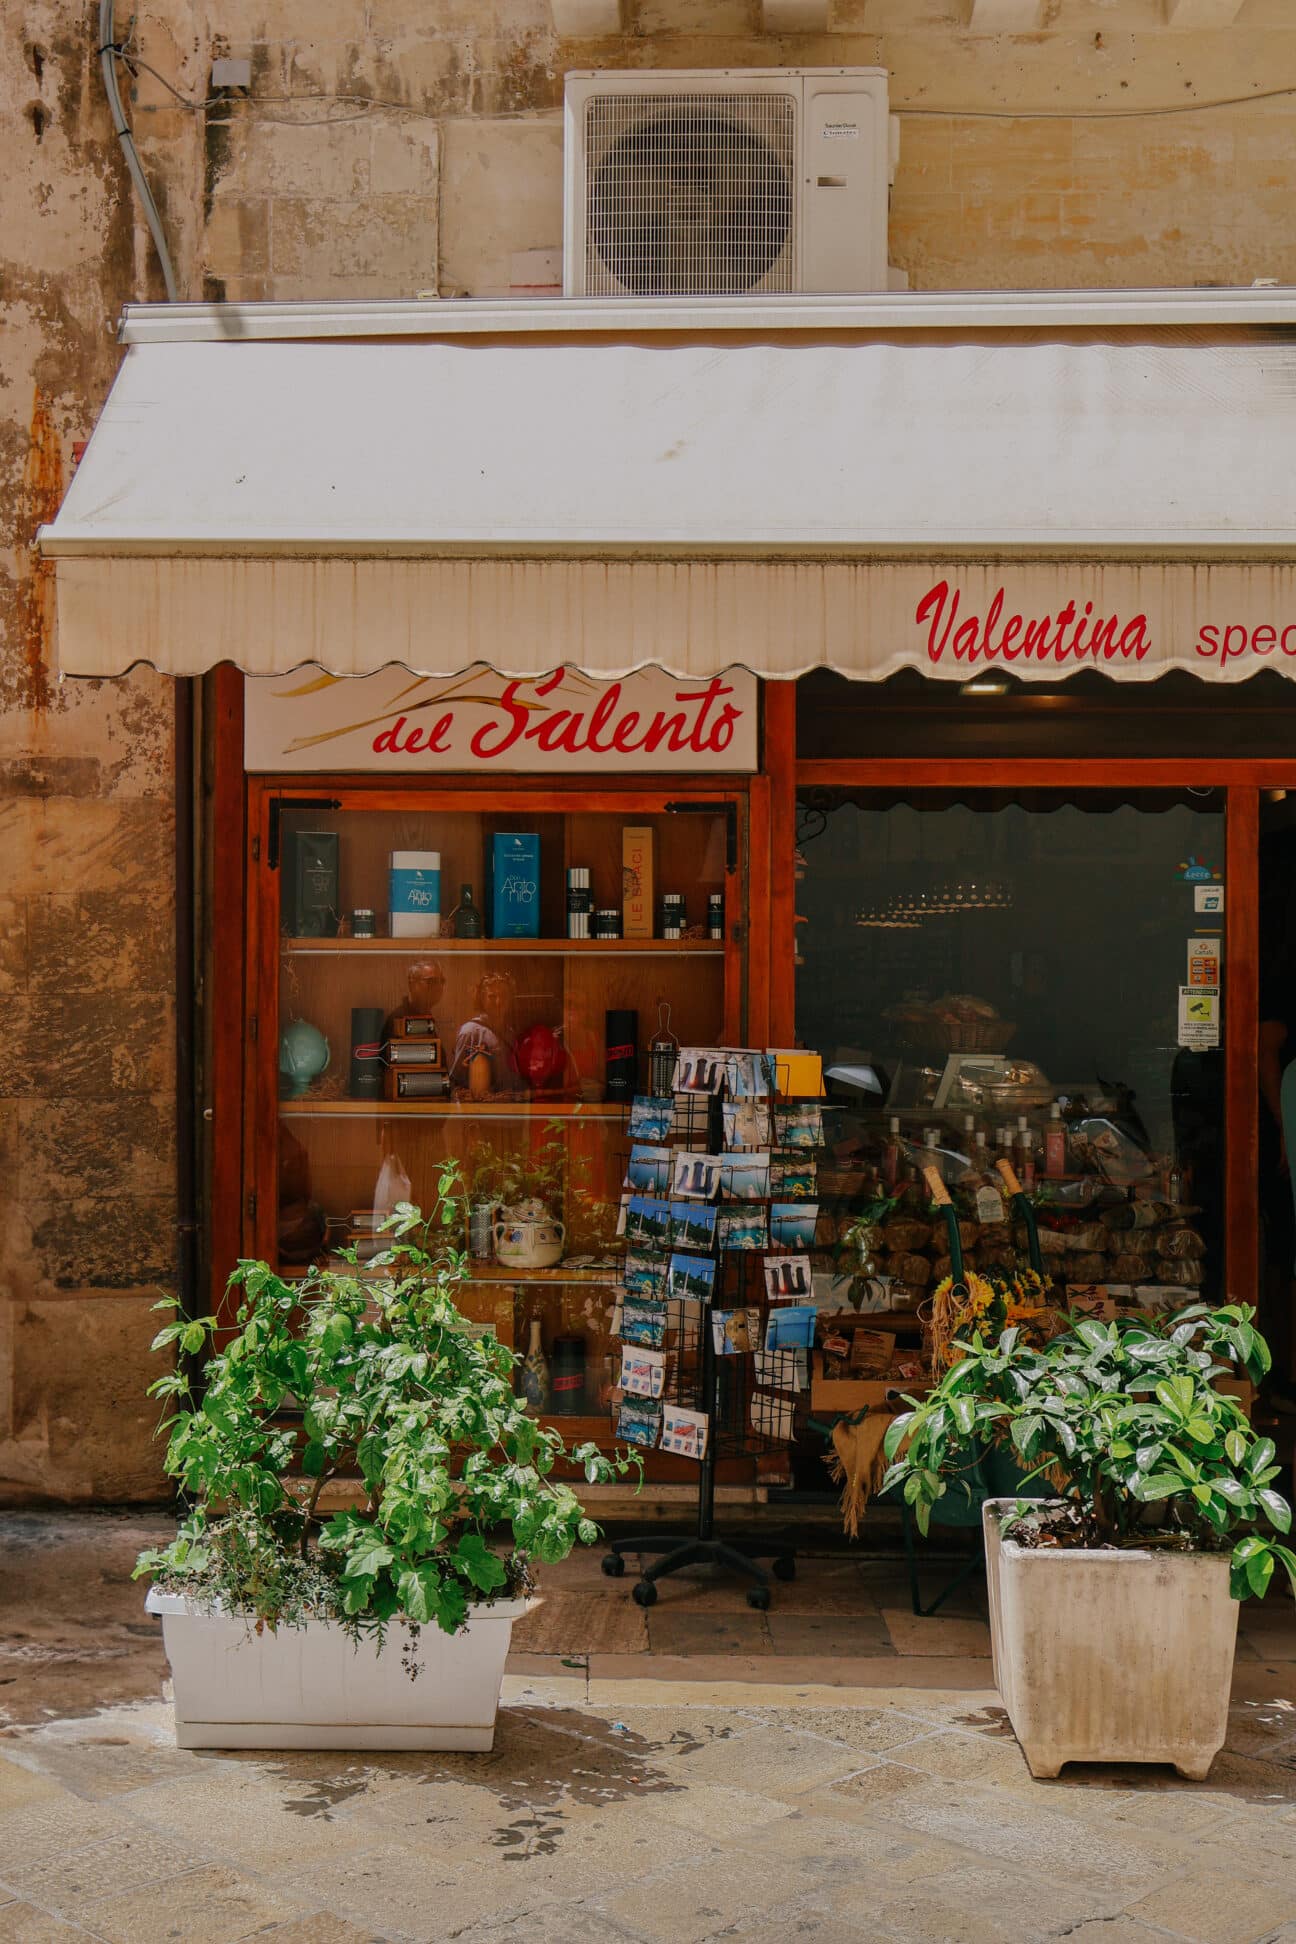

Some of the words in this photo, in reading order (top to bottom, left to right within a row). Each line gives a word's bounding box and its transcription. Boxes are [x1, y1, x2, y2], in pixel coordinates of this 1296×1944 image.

[915, 580, 1152, 663] Valentina
[372, 712, 454, 754] del
[470, 666, 743, 759] Salento
